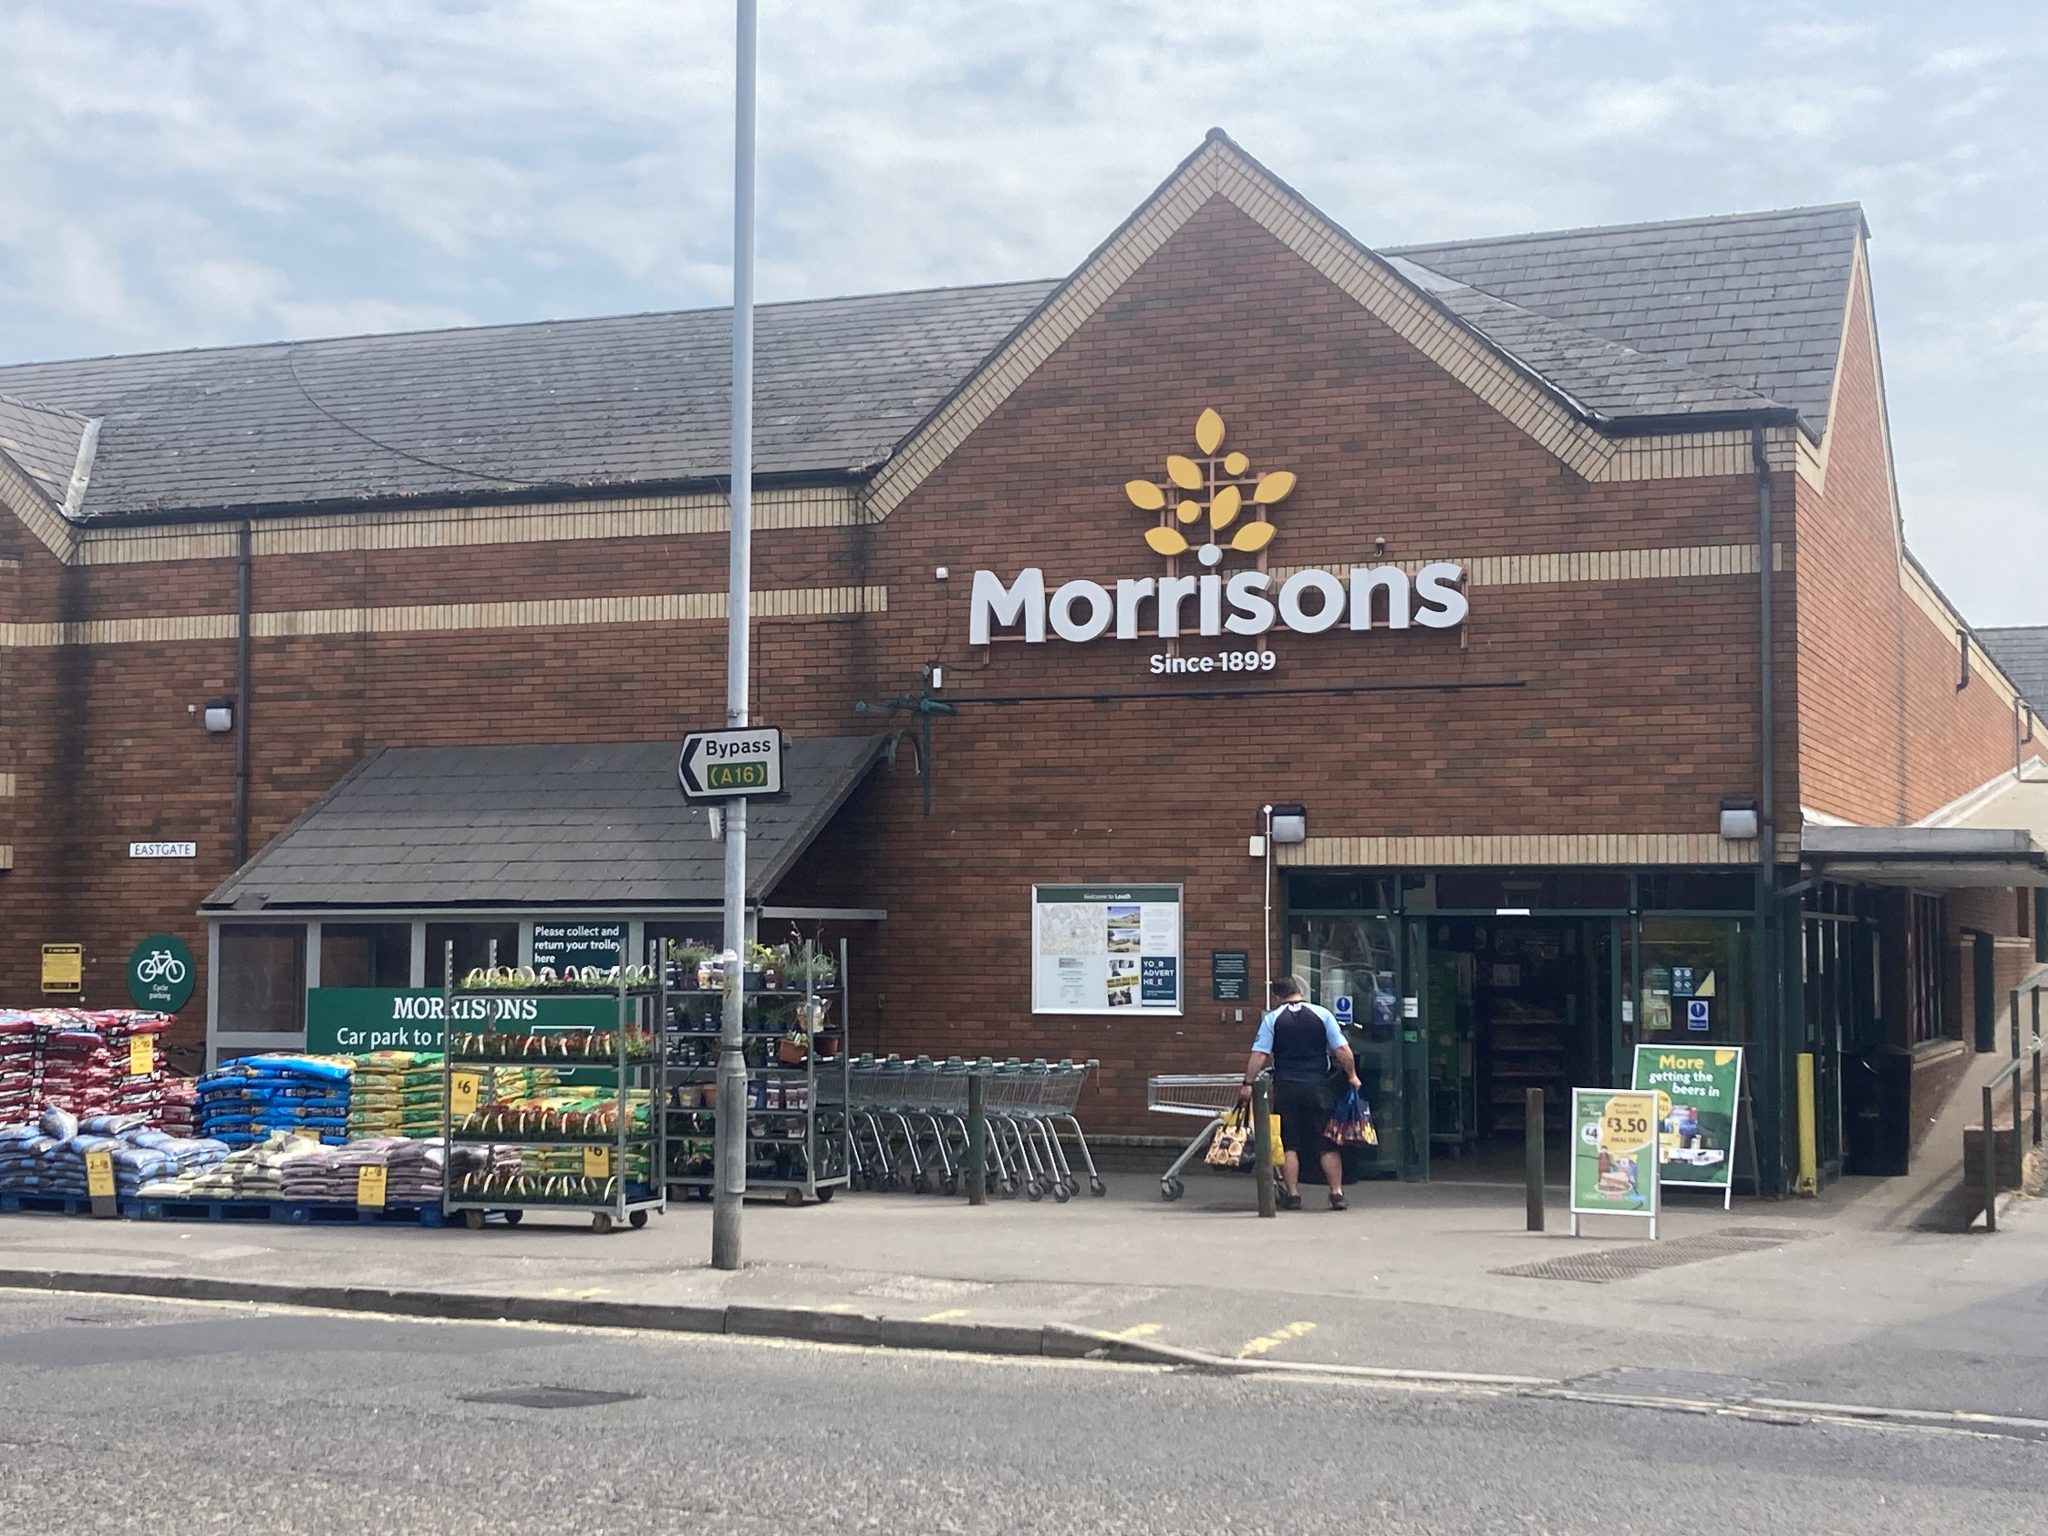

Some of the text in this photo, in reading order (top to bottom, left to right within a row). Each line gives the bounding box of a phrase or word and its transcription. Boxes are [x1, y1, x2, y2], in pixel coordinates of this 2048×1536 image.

[970, 543, 1469, 645] Morrisons
[1150, 650, 1276, 674] Since 1899
[706, 740, 771, 758] Bypass
[135, 844, 191, 855] EASTGATE
[535, 926, 619, 936] Please collect and
[535, 939, 620, 952] return your trolley
[535, 953, 555, 963] here
[153, 983, 168, 993] Cycle
[149, 992, 171, 1001] parking
[336, 1027, 367, 1045] Car
[370, 1027, 409, 1048] park
[414, 1029, 432, 1045] to
[1659, 1054, 1705, 1070] More
[1649, 1071, 1713, 1084] getting the
[458, 1080, 471, 1094] £6
[1672, 1082, 1720, 1097] beers in
[1607, 1117, 1647, 1133] £3.50
[1586, 1128, 1598, 1139] £4
